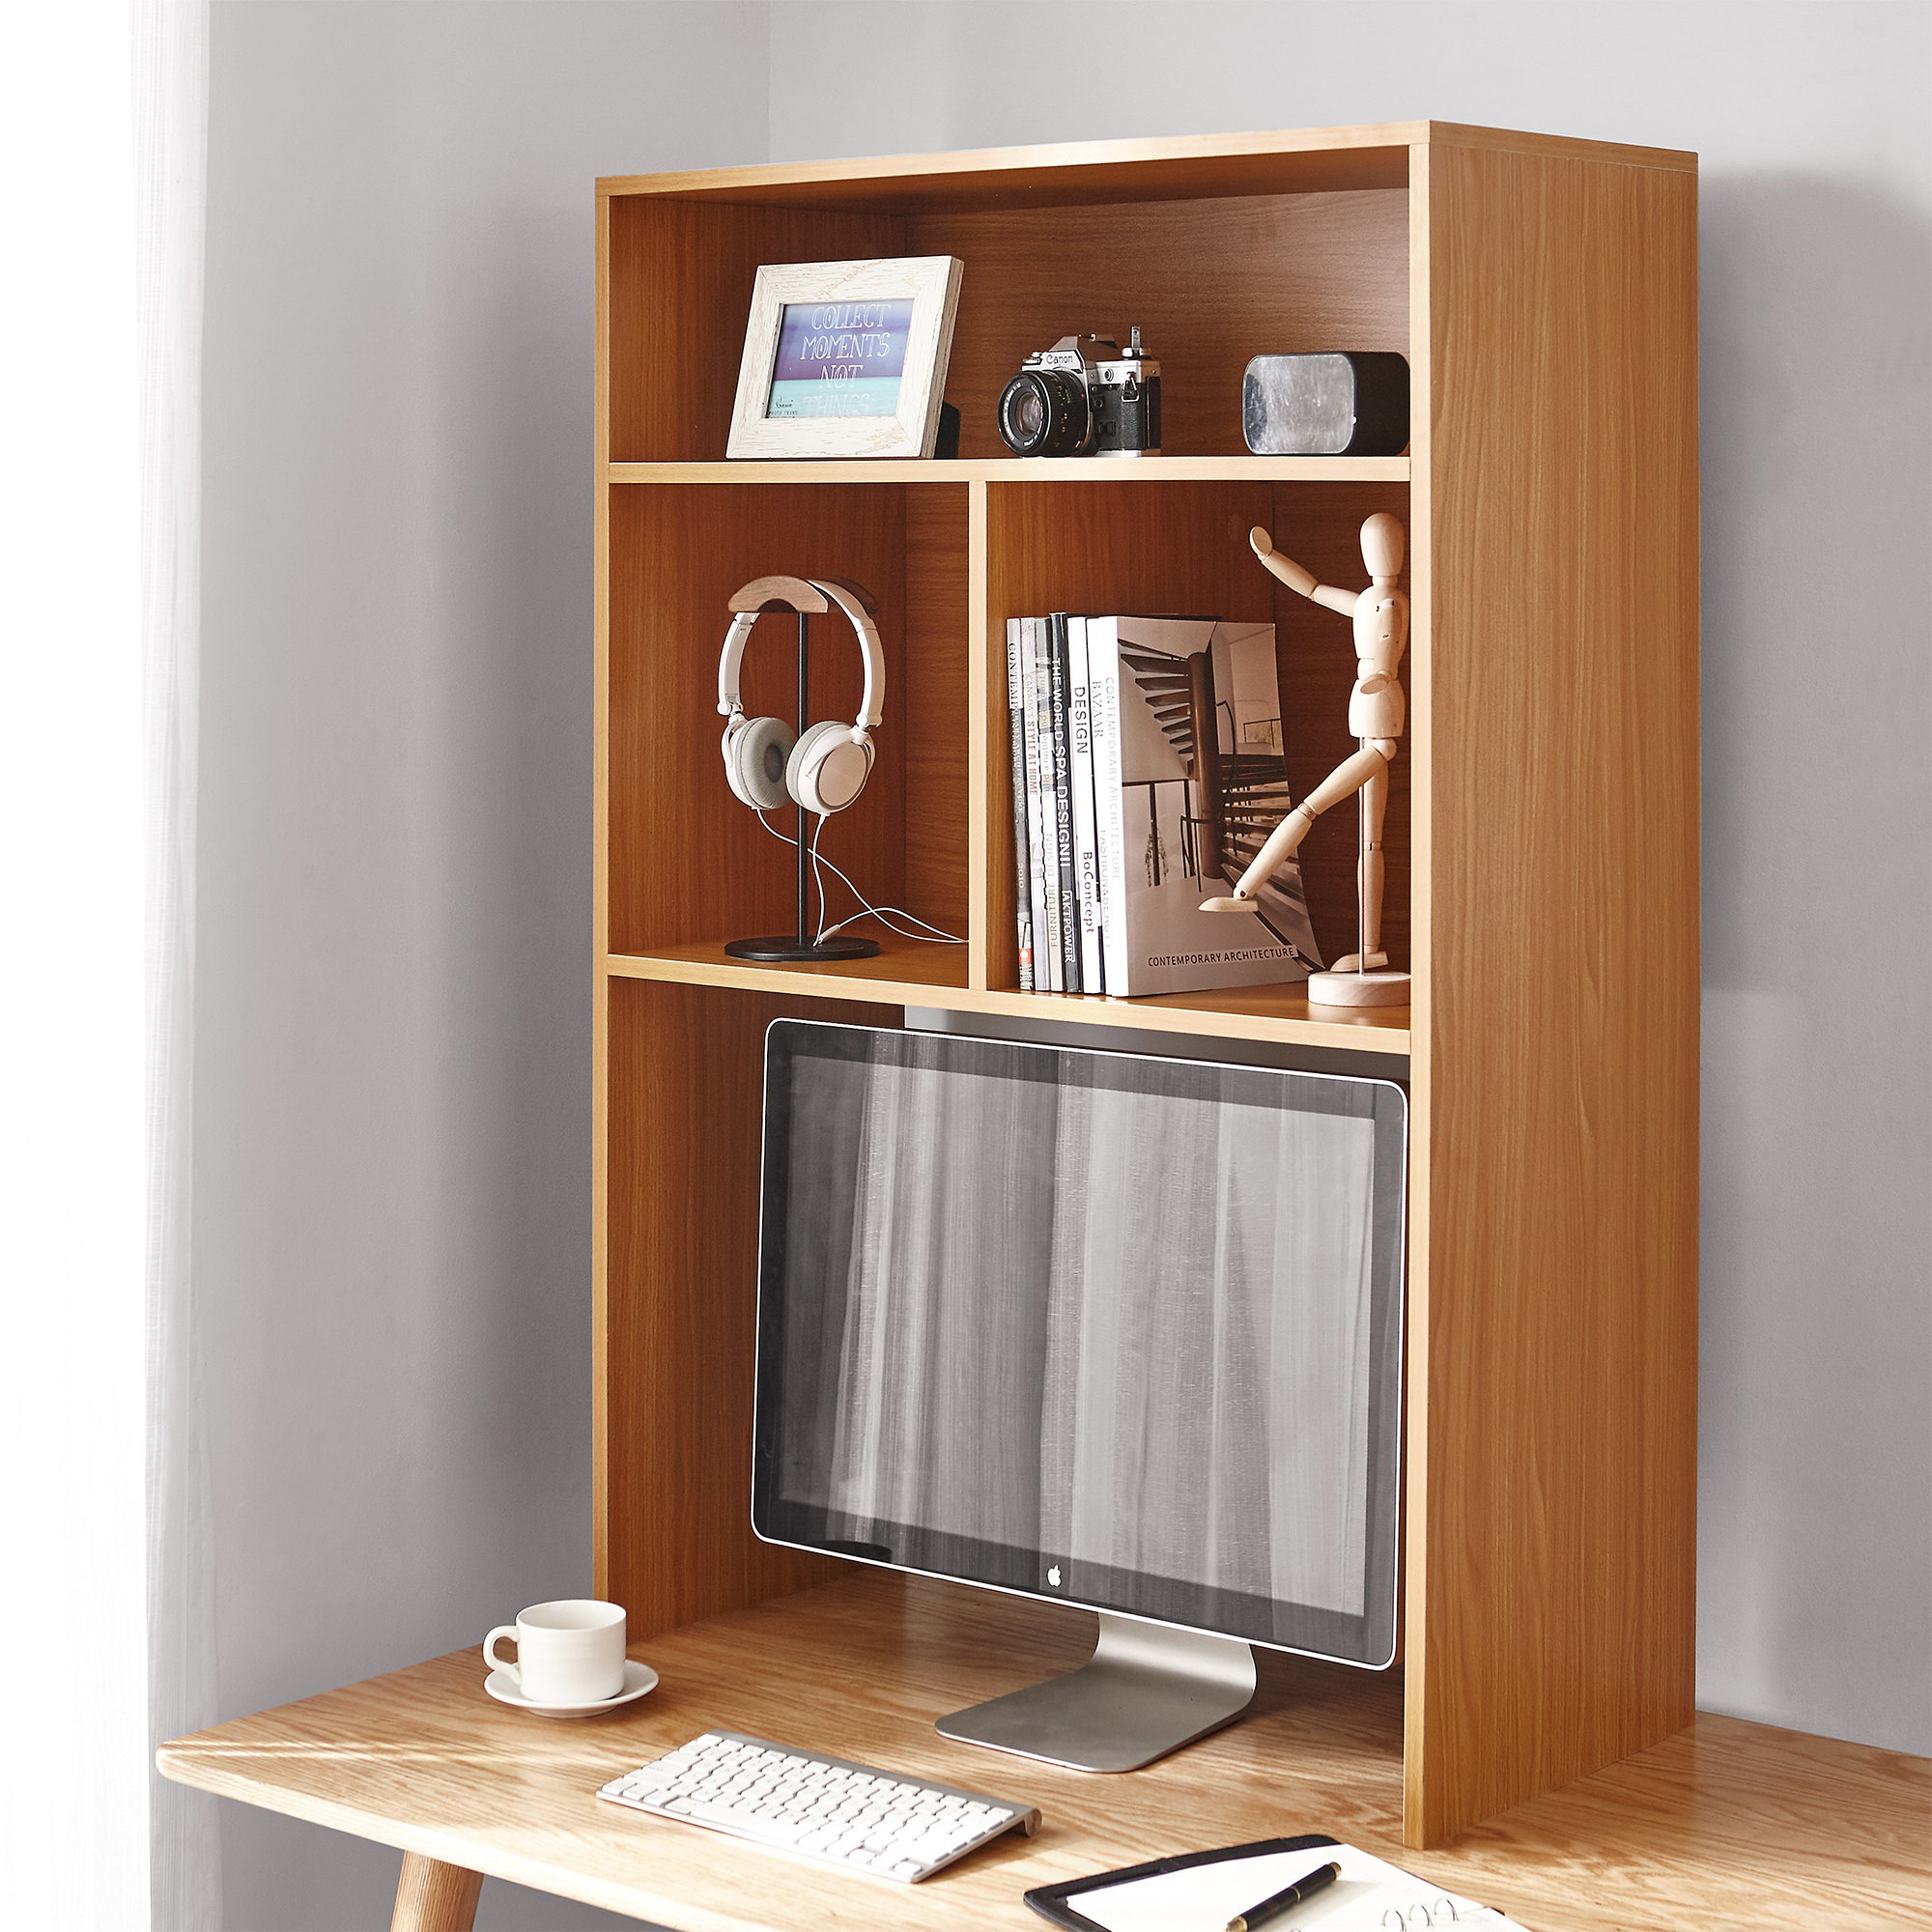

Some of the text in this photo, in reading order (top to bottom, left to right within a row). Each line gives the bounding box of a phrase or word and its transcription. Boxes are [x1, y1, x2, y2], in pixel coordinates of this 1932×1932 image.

[811, 303, 891, 330] COLLECT
[800, 332, 891, 360] MOMENTS
[1046, 354, 1073, 364] Canon
[819, 364, 864, 388] NOT
[1053, 687, 1064, 741] WORLD
[1073, 687, 1089, 753] DESIGN
[1092, 681, 1104, 738] BAZAAR
[1027, 721, 1037, 752] STYLE
[1028, 753, 1037, 765] AT
[1055, 745, 1066, 780] SPA
[1029, 768, 1037, 796] HOME
[1105, 677, 1121, 880] CONTEMPORARY ARCHITECTURE
[1046, 834, 1058, 948] FURNITURE DESIGN
[1083, 851, 1094, 933] BoConcept
[1148, 947, 1294, 967] CONTEMPORARY ARCHITECTURE
